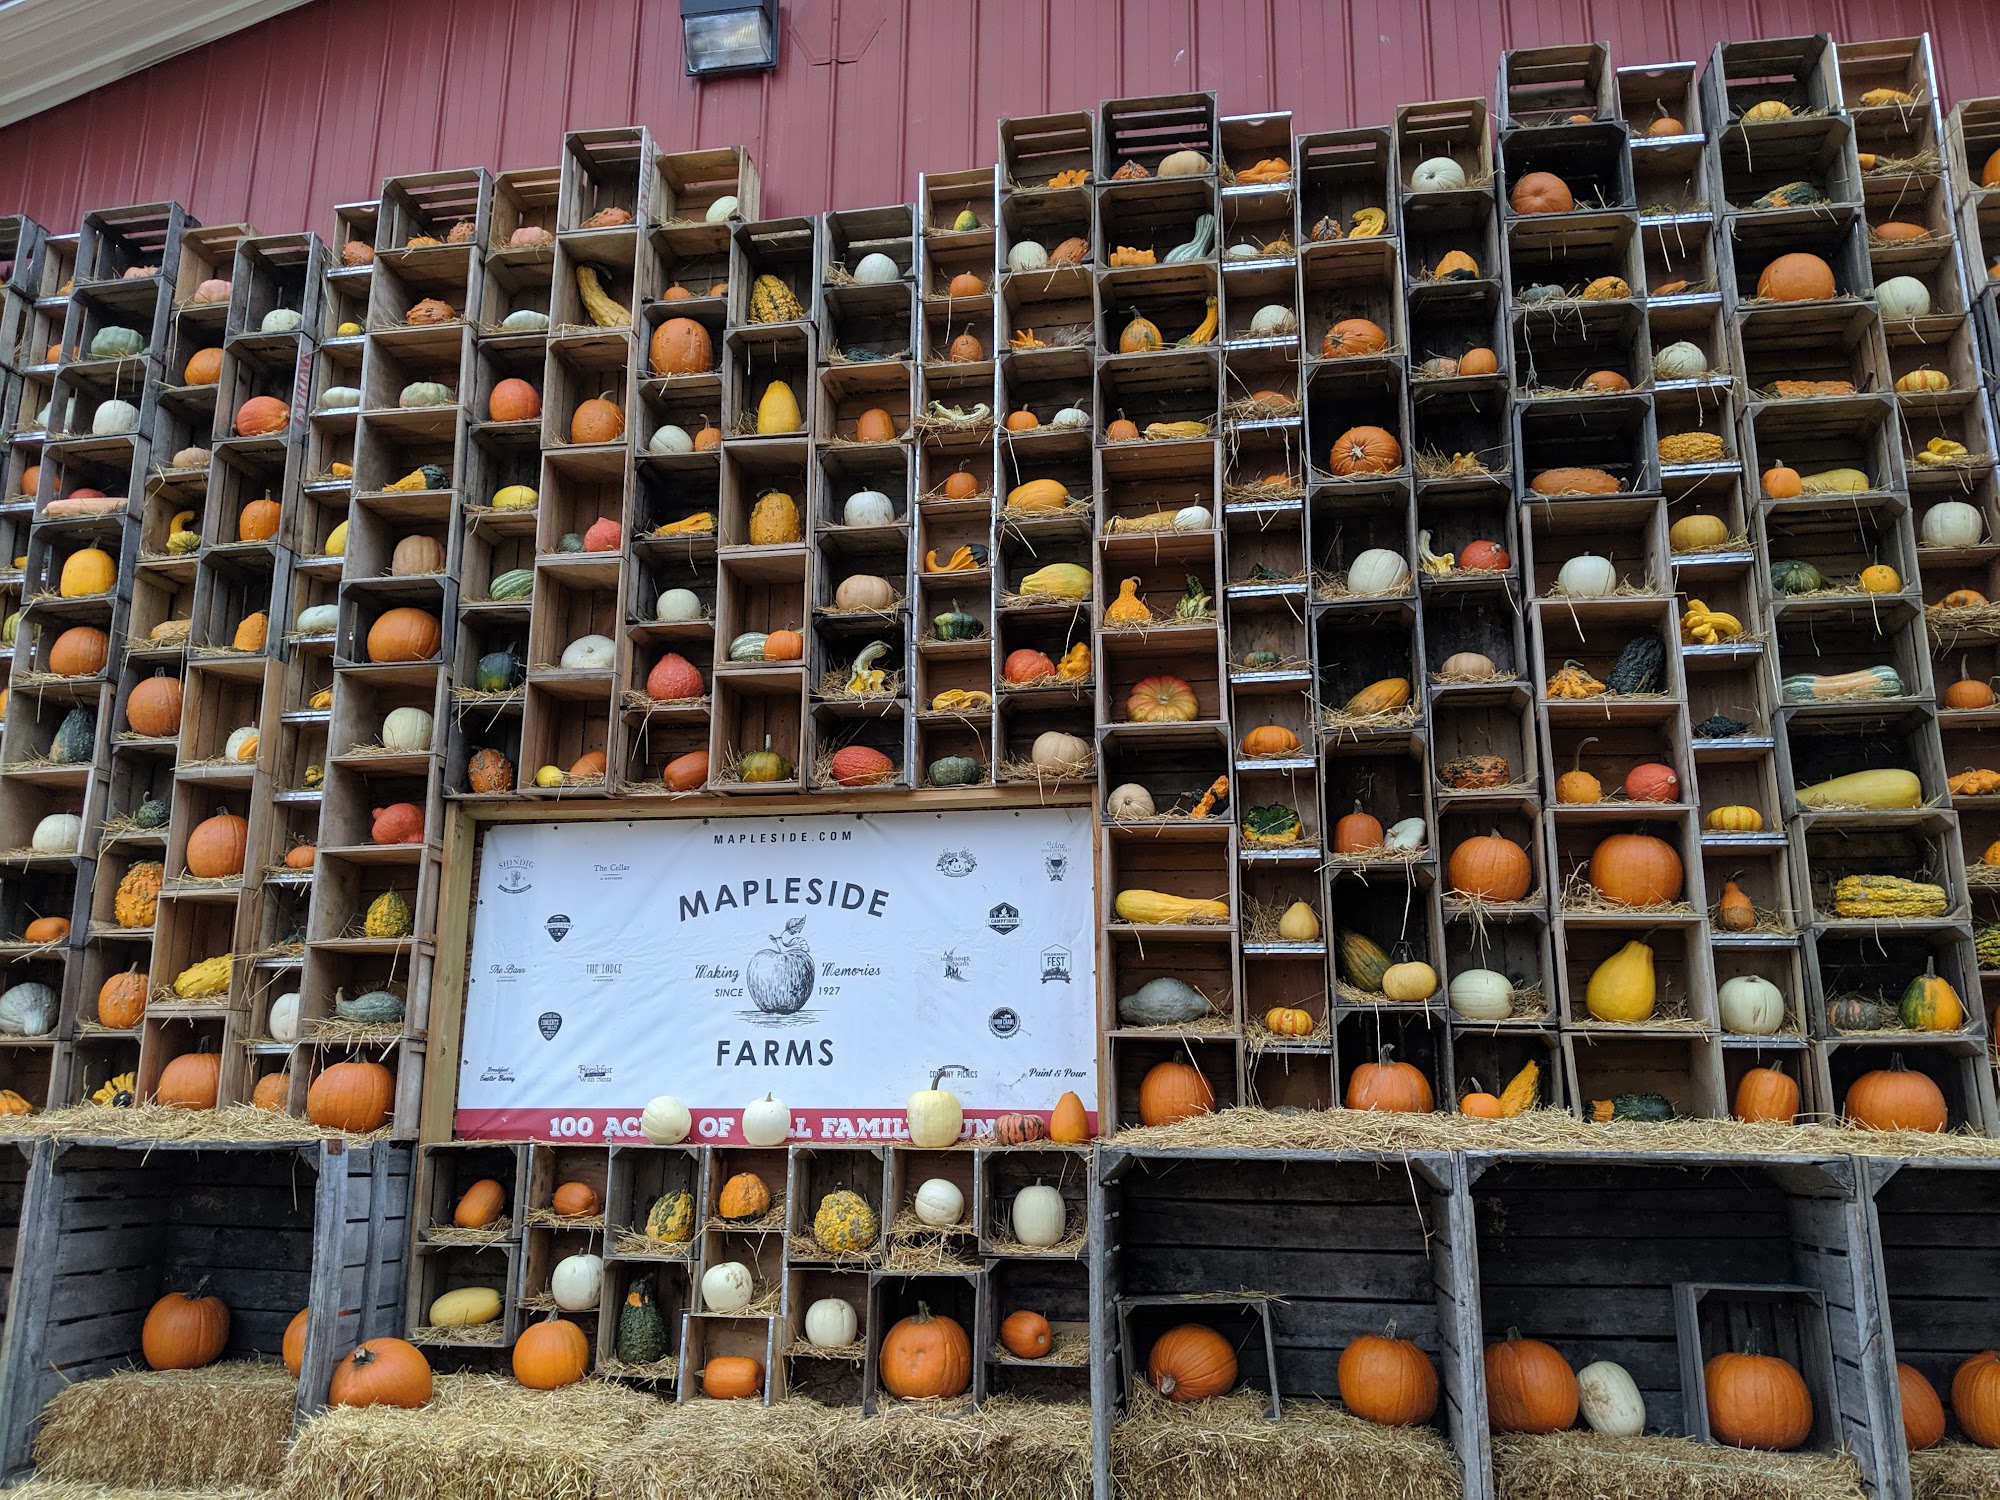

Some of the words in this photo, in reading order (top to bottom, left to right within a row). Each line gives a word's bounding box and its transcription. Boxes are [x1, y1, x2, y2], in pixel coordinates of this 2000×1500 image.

[714, 831, 852, 845] MAPLESIDE.COM
[498, 859, 535, 870] SHINDIG
[593, 864, 607, 872] The
[609, 863, 630, 872] Cellar
[679, 877, 890, 922] MAPLESIDE
[1047, 956, 1066, 967] FEST
[489, 964, 503, 974] The
[586, 964, 599, 975] THE
[601, 963, 623, 974] LODGE
[695, 964, 740, 983] Making
[822, 962, 881, 977] Memories
[714, 988, 744, 998] SINCE
[818, 986, 841, 996] 1927
[716, 1038, 834, 1067] FARMS
[577, 1064, 613, 1075] Breakfast
[1029, 1067, 1053, 1078] Paint
[1053, 1069, 1062, 1077] &
[1064, 1067, 1087, 1078] Pour
[549, 1116, 595, 1138] 100
[698, 1116, 735, 1138] OF
[820, 1117, 910, 1139] FAMIL
[958, 1118, 996, 1140] UN
